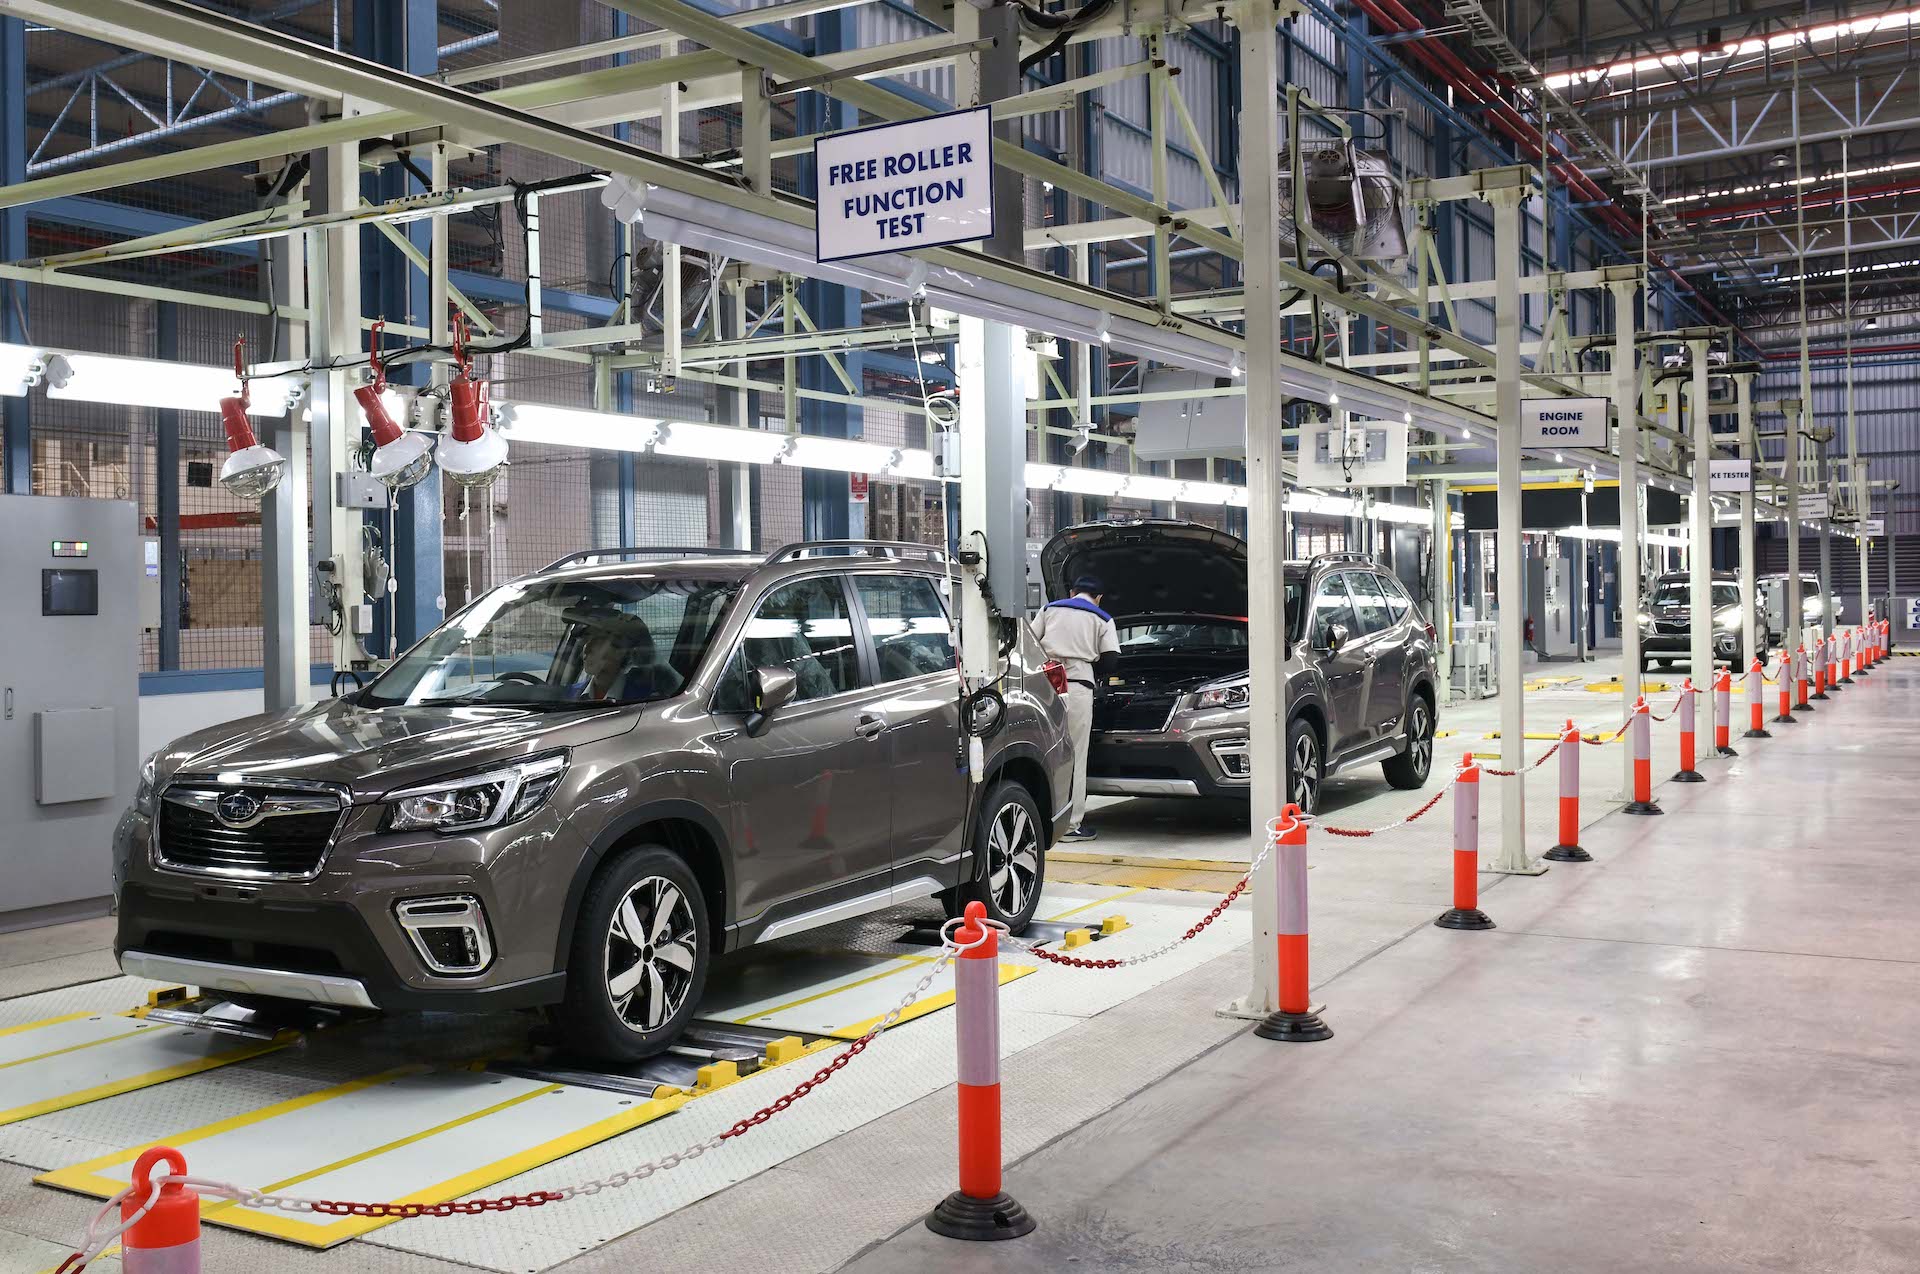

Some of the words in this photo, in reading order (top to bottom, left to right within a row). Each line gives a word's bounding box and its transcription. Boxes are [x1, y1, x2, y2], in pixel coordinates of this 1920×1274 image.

[829, 159, 877, 186] FREE
[884, 142, 973, 177] ROLLER
[844, 178, 964, 219] FUNCTION
[876, 212, 925, 239] TEST
[1539, 412, 1583, 421] ENGINE
[1541, 426, 1579, 435] ROOM
